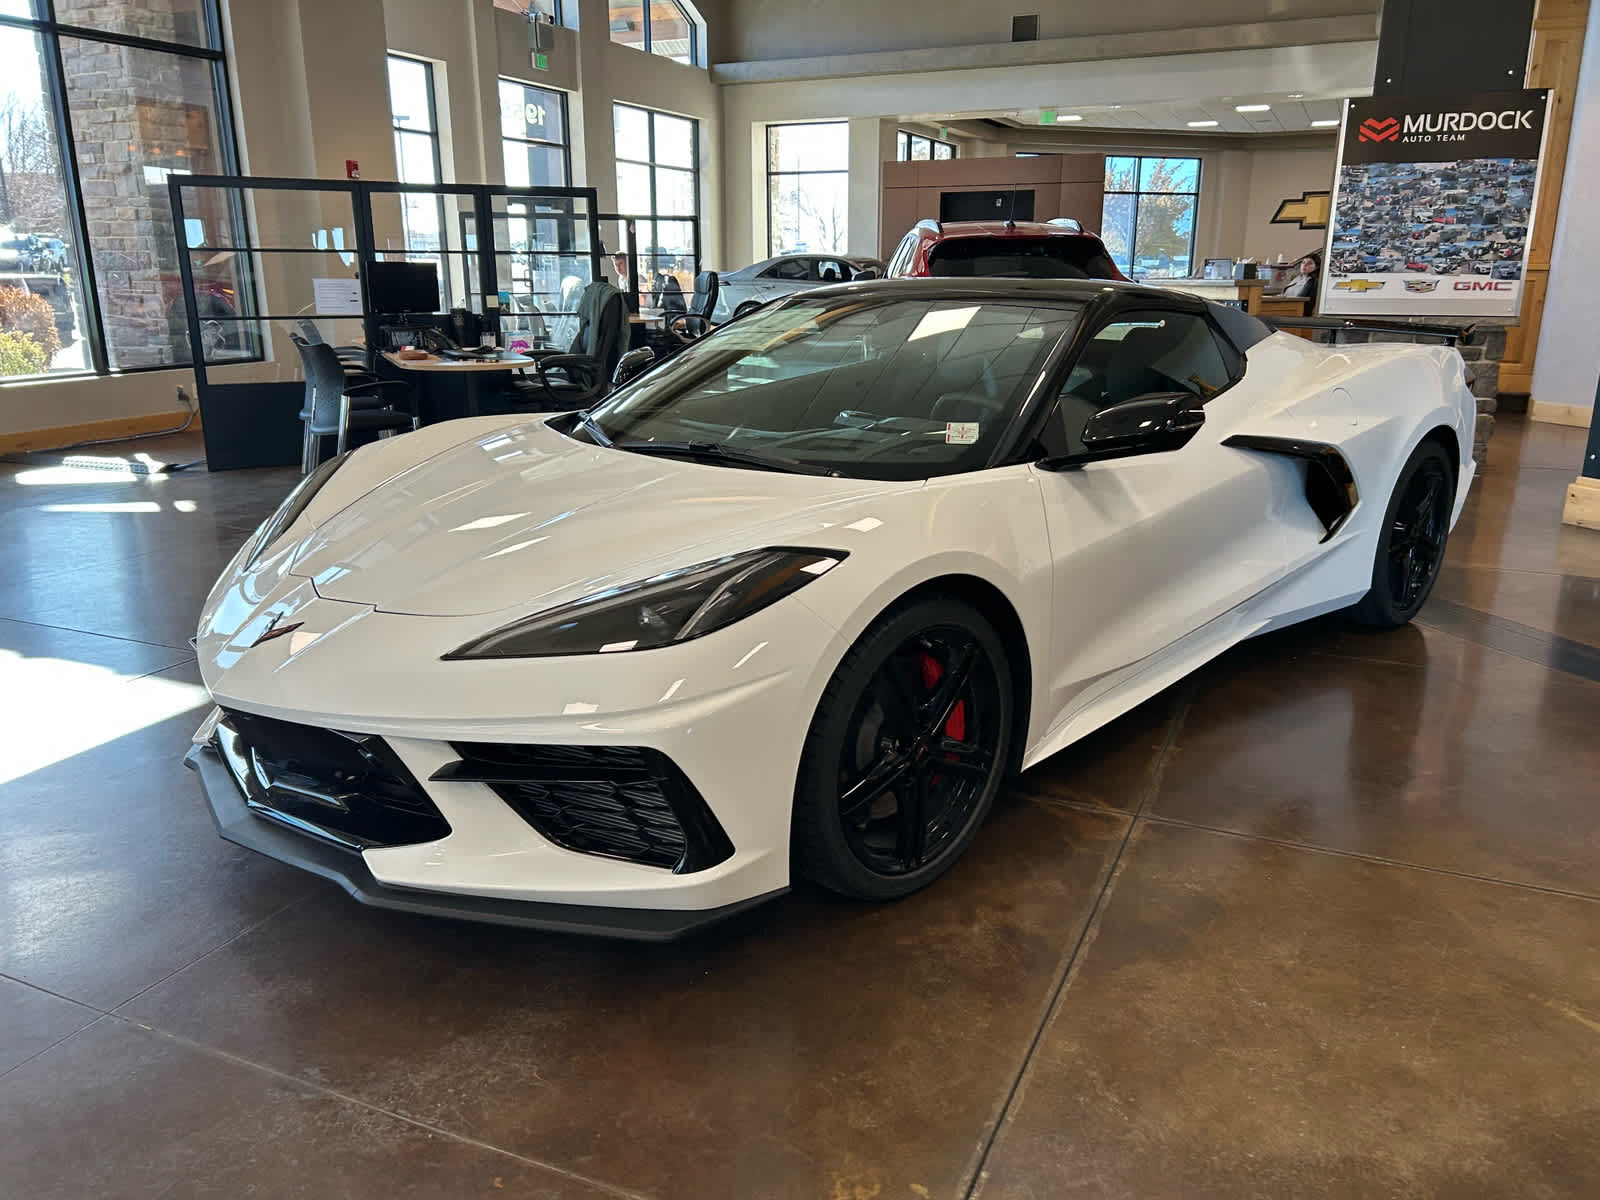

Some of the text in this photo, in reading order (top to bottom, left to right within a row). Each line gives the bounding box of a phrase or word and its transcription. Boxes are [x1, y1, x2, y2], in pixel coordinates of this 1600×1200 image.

[1403, 110, 1534, 133] MURDOCK
[1402, 134, 1465, 143] AUTO TEAM
[1453, 281, 1513, 292] GMC
